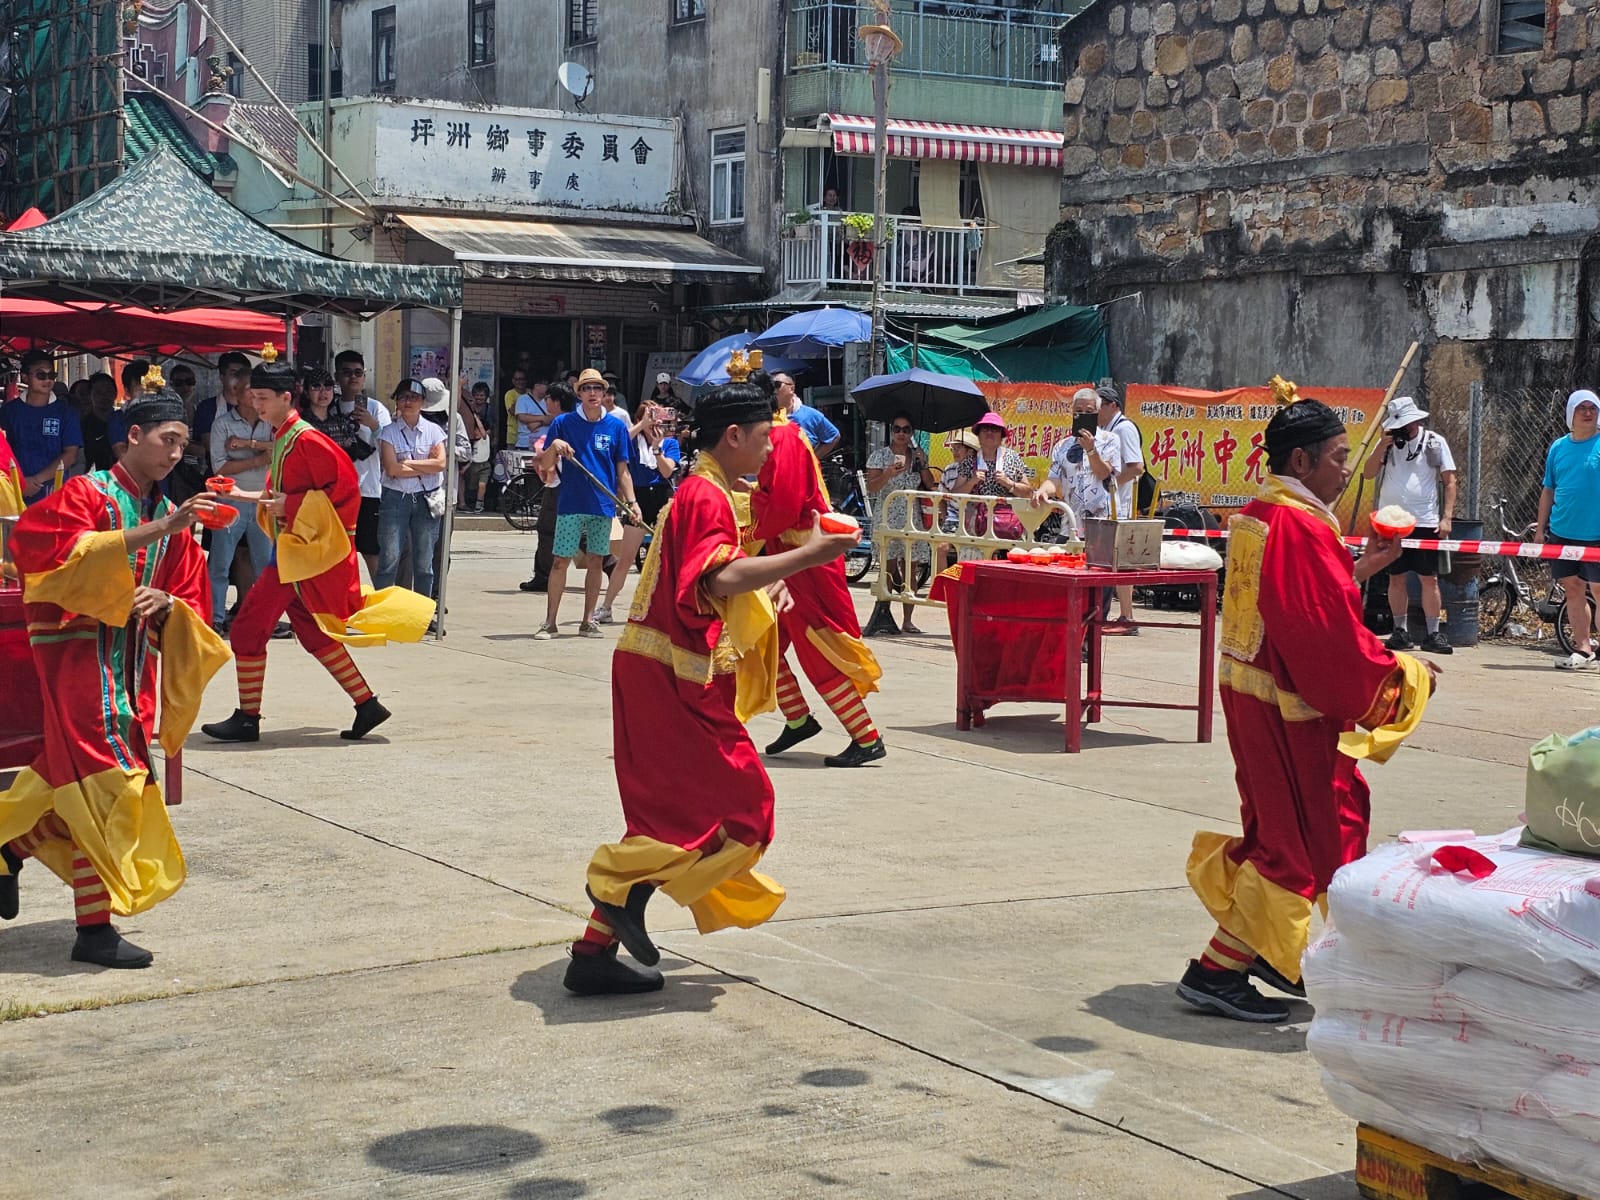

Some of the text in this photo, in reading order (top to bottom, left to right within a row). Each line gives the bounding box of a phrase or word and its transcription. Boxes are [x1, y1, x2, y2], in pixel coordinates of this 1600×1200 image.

[410, 119, 653, 165] 坪洲鄉事委員會
[1151, 428, 1265, 484] 坪洲中元
